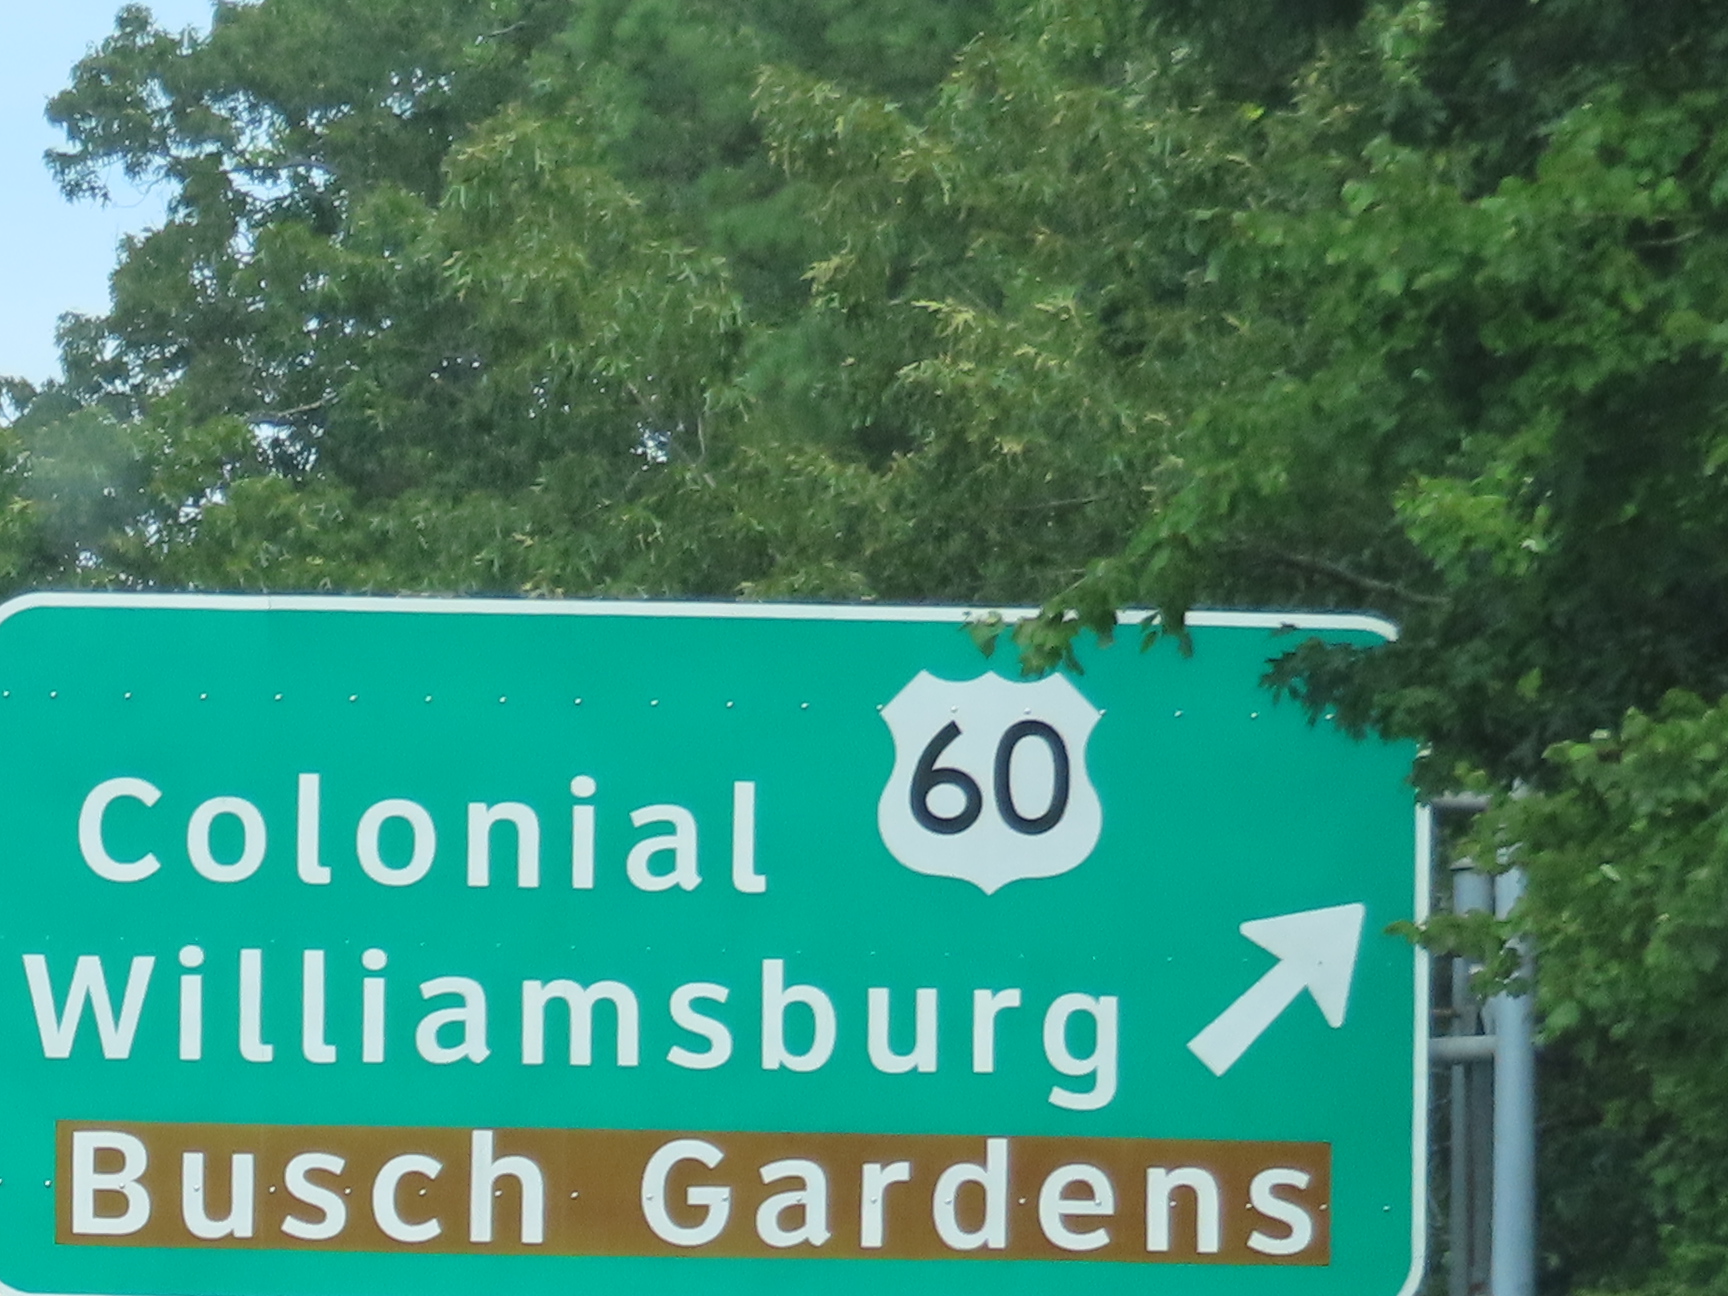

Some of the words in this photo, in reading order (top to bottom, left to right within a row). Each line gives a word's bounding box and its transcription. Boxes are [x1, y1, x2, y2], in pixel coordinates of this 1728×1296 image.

[78, 773, 766, 893] Colonial
[909, 719, 1071, 837] 60
[22, 945, 1121, 1110] Williamsburg
[70, 1129, 545, 1244] Busch
[640, 1137, 1314, 1255] Gardens
